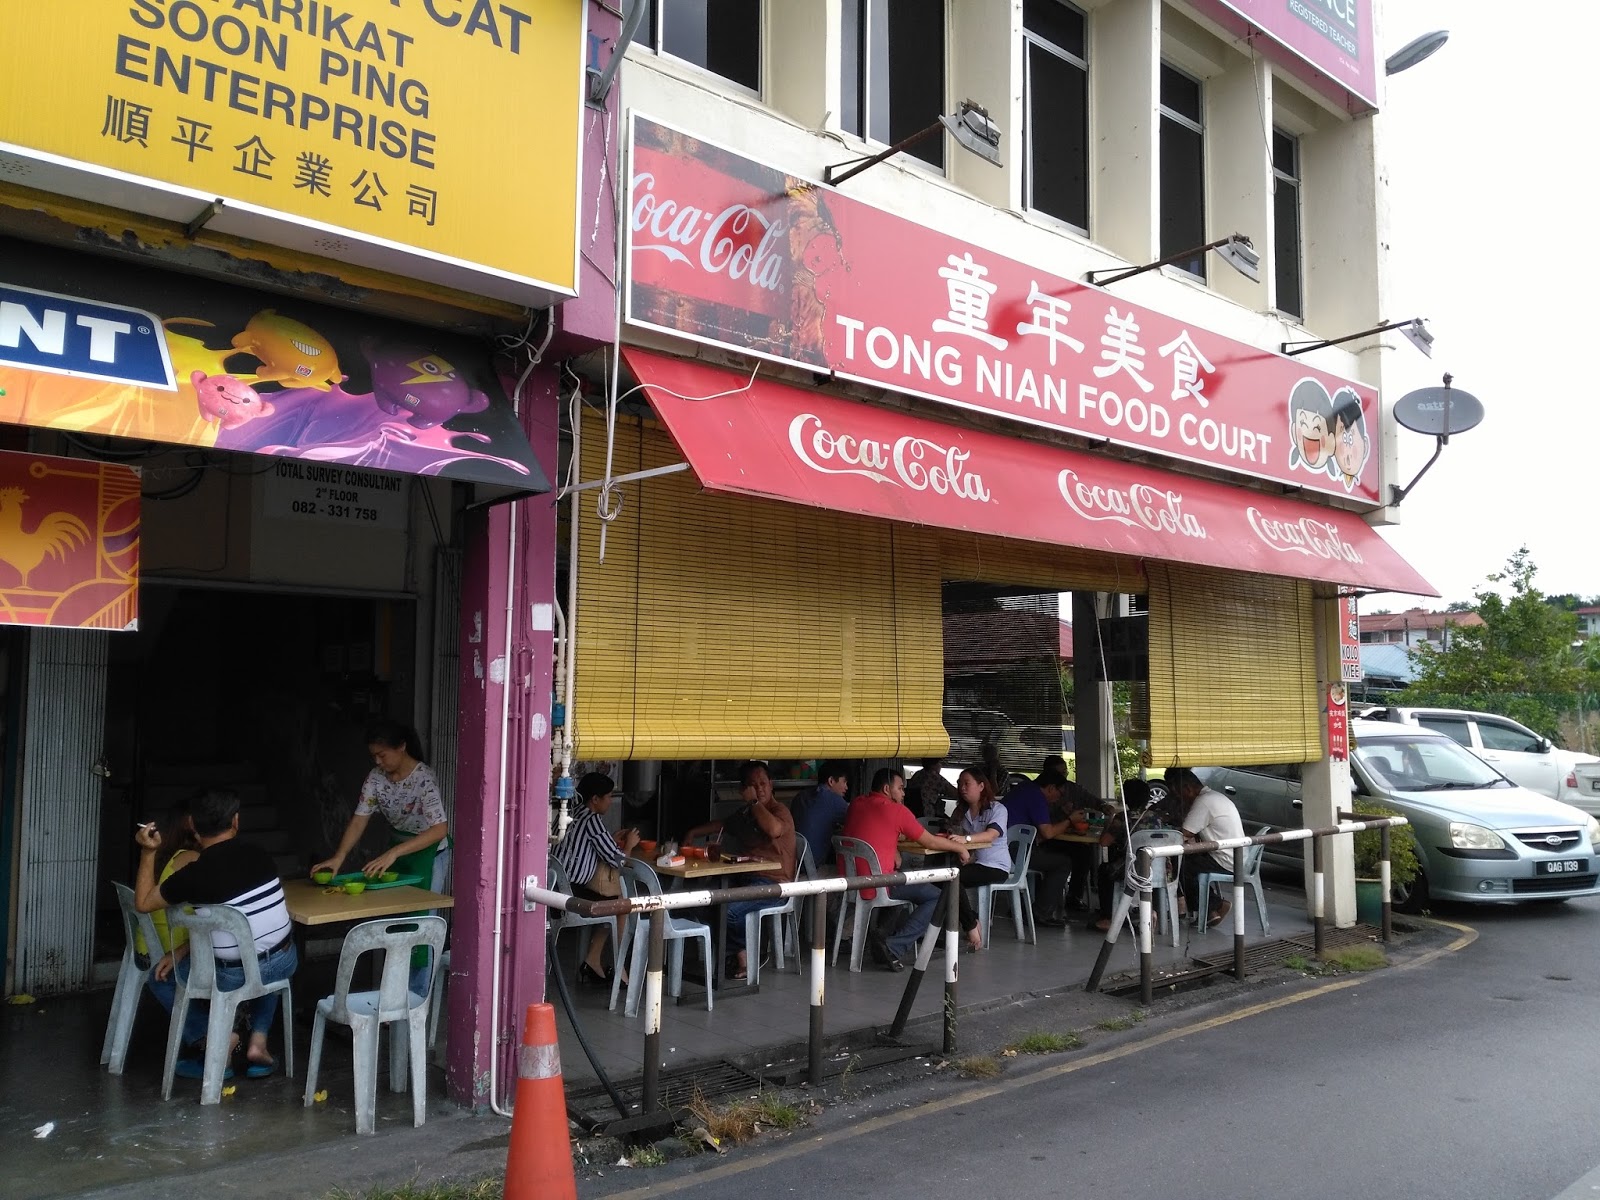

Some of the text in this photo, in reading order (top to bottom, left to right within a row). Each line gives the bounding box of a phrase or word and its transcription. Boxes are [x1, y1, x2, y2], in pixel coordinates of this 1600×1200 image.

[211, 0, 414, 68] ARIKAT
[424, 0, 532, 55] CAT
[1289, 0, 1356, 56] REGISTERED TEACHER
[129, 0, 429, 118] SOON PING
[115, 34, 436, 169] ENTERPRISE
[101, 95, 438, 226] 順平企業公司
[0, 301, 131, 363] NT
[932, 251, 1216, 408] 童年美食
[836, 314, 964, 387] TONG
[976, 357, 1067, 417] NIAN
[1079, 383, 1170, 438] FOOD
[1179, 412, 1272, 464] COURT
[275, 461, 402, 492] TOTAL SURVEY CONSULTANT
[788, 413, 991, 503] Coca-Cola
[291, 500, 316, 515] 082
[327, 504, 350, 518] 331
[354, 507, 378, 521] 758
[329, 489, 358, 503] FLOOR
[1057, 468, 1207, 539] Coca-Cola
[1246, 506, 1364, 564] Coca-Cola
[1341, 645, 1359, 661] KOLO
[1342, 663, 1360, 679] MEE
[1547, 861, 1579, 873] QAG 1139
